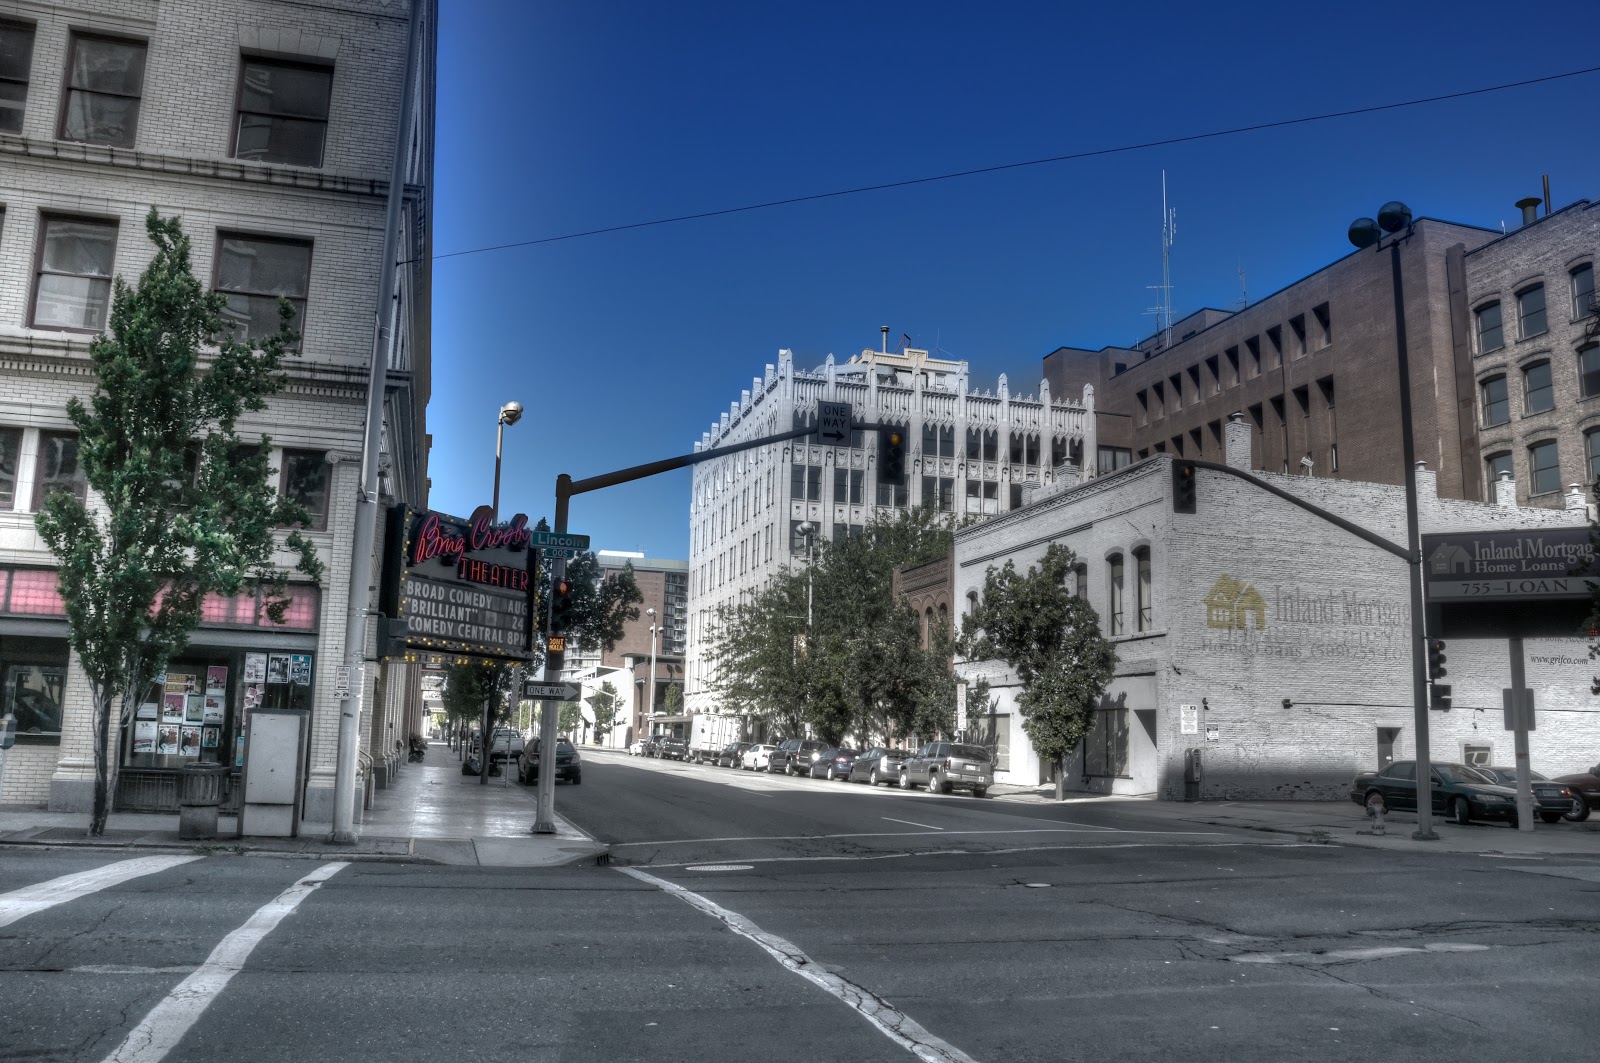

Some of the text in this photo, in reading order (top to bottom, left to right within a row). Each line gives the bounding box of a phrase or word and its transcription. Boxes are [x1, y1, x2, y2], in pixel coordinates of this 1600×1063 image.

[823, 417, 846, 429] WAY
[824, 405, 846, 417] ONE
[414, 514, 466, 563] Bing
[538, 533, 584, 547] Lincoln
[1473, 537, 1599, 564] Inland Mortgag
[460, 557, 529, 590] THEATER
[1474, 559, 1566, 573] Home Loans
[406, 580, 528, 616] BROAD COMEDY AUG
[1274, 585, 1335, 624] Inland
[405, 596, 524, 630] "BRILLIANT" 24
[408, 615, 527, 647] COMEDY CENTRAL 8PM
[1530, 655, 1589, 666] www.grifco.com
[529, 686, 565, 696] ONE WAY
